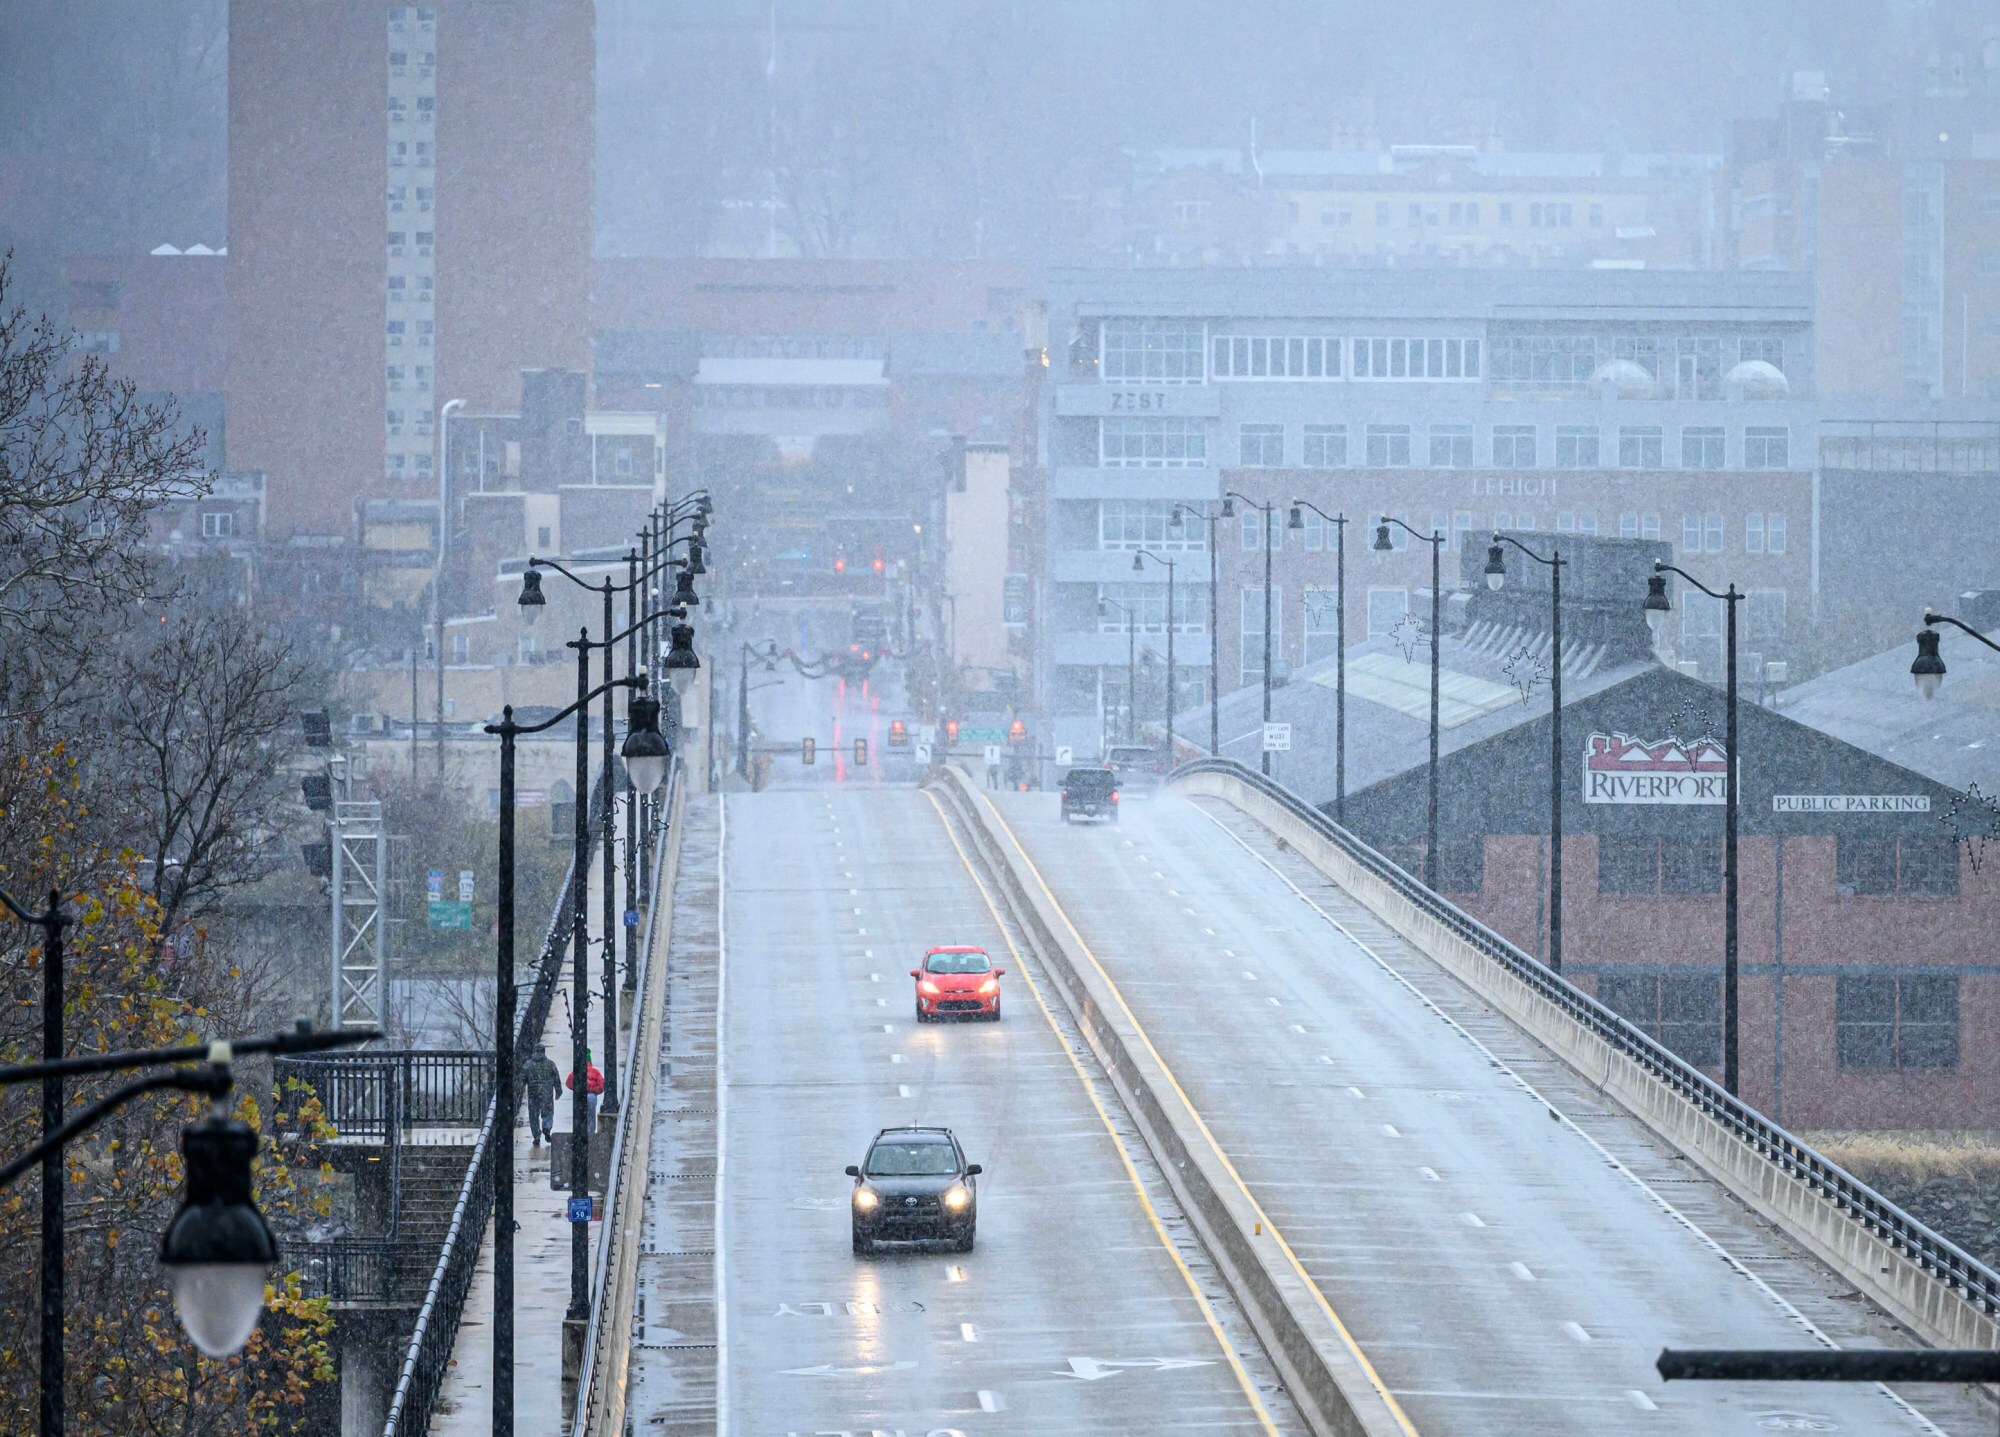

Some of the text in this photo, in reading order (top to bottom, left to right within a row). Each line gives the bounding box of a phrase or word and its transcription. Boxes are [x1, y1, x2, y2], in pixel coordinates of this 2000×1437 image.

[1111, 392, 1166, 409] ZEST
[1472, 478, 1557, 496] LEHIGH
[1776, 797, 1928, 810] PUBLIC PARKING
[772, 1301, 926, 1317] ONLY
